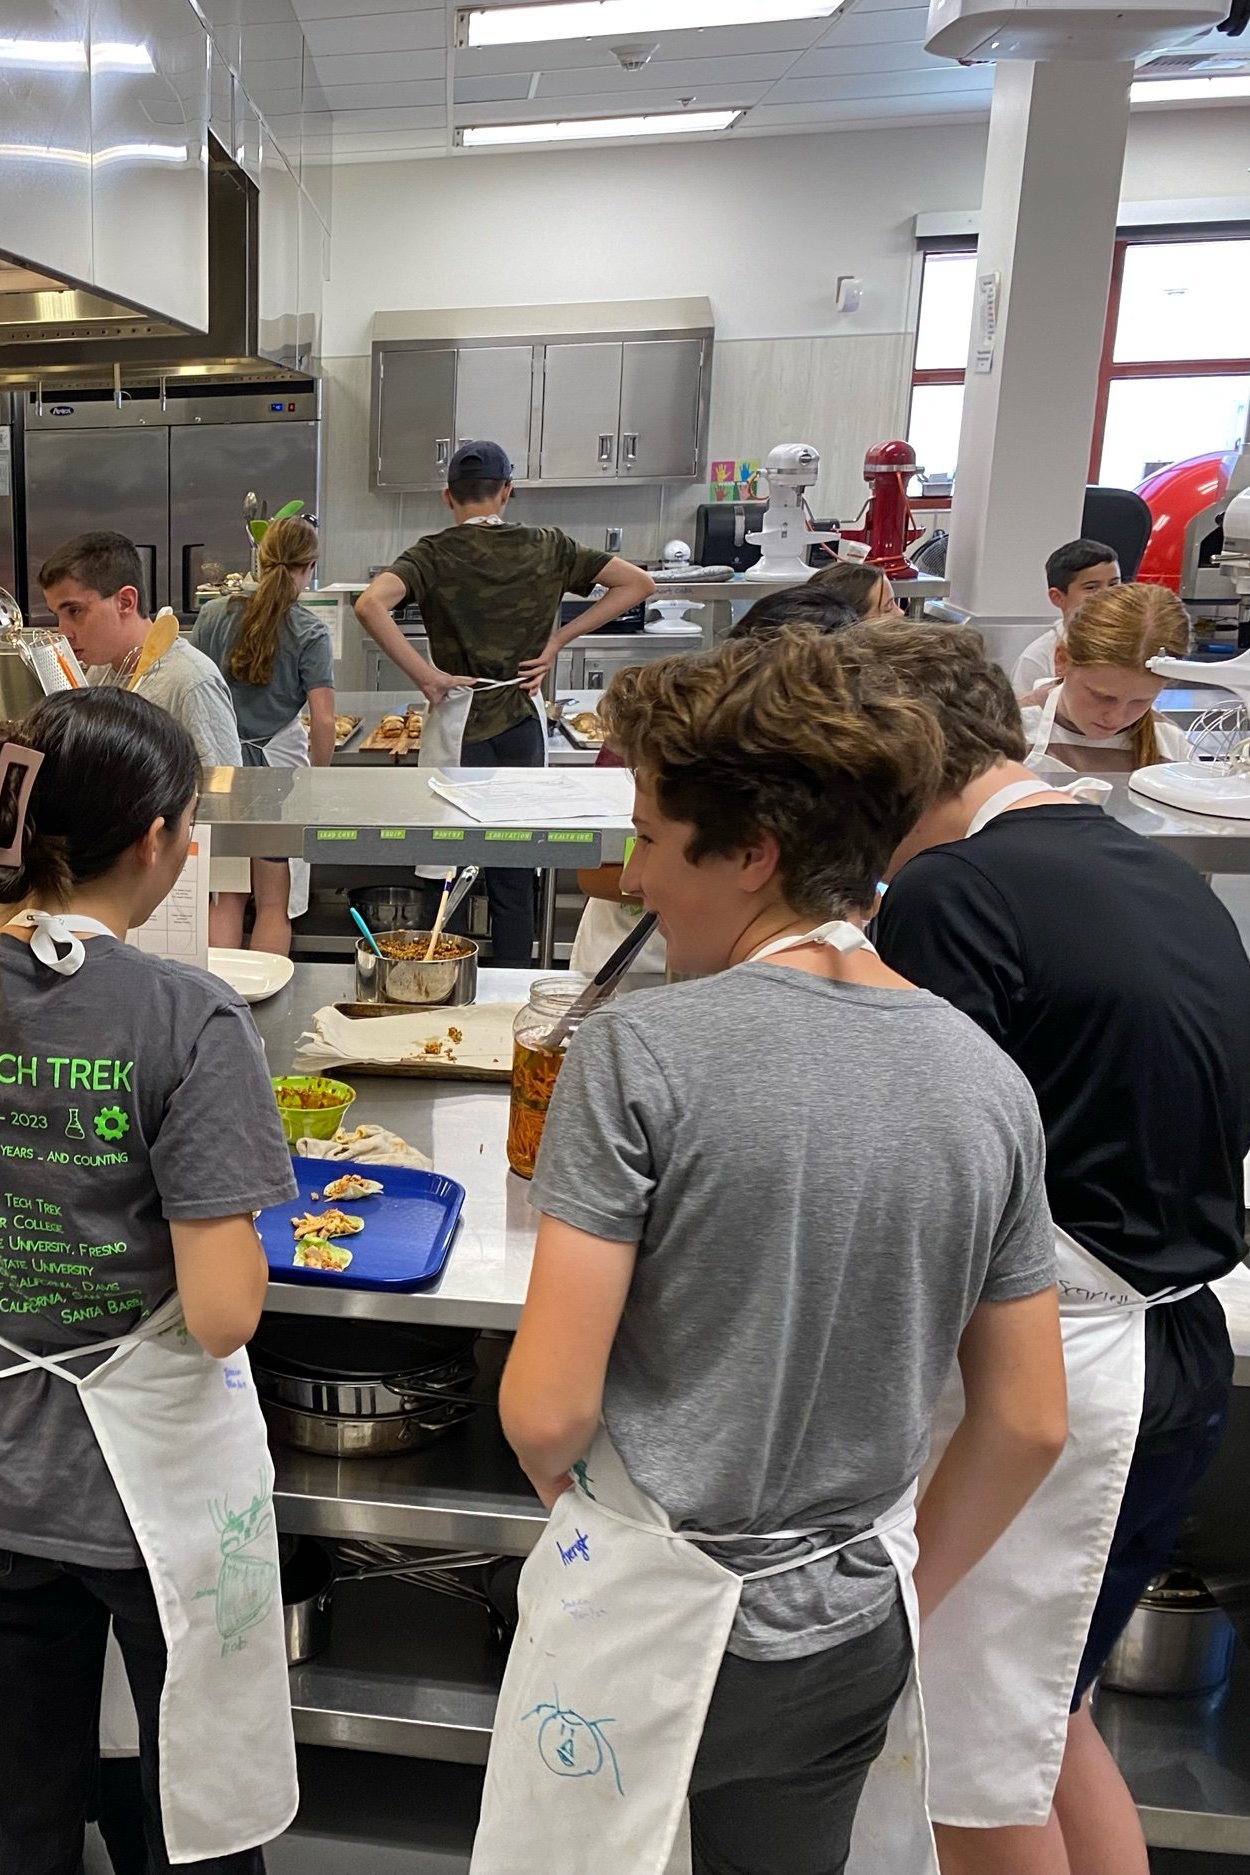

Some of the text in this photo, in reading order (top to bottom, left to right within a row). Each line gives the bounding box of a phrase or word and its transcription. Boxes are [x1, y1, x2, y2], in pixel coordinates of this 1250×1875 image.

[47, 1057, 134, 1092] TREK
[10, 1111, 48, 1129] 2023
[0, 1146, 34, 1160] YEARS
[47, 1151, 70, 1165] AND
[73, 1152, 129, 1167] COUNTING
[4, 1193, 33, 1210] TECH
[35, 1198, 63, 1217] TREK
[13, 1214, 65, 1234] COLLEGE
[79, 1242, 127, 1257] FRESNO
[31, 1257, 94, 1276] UNIVERSITY
[60, 1305, 104, 1325] SANTA
